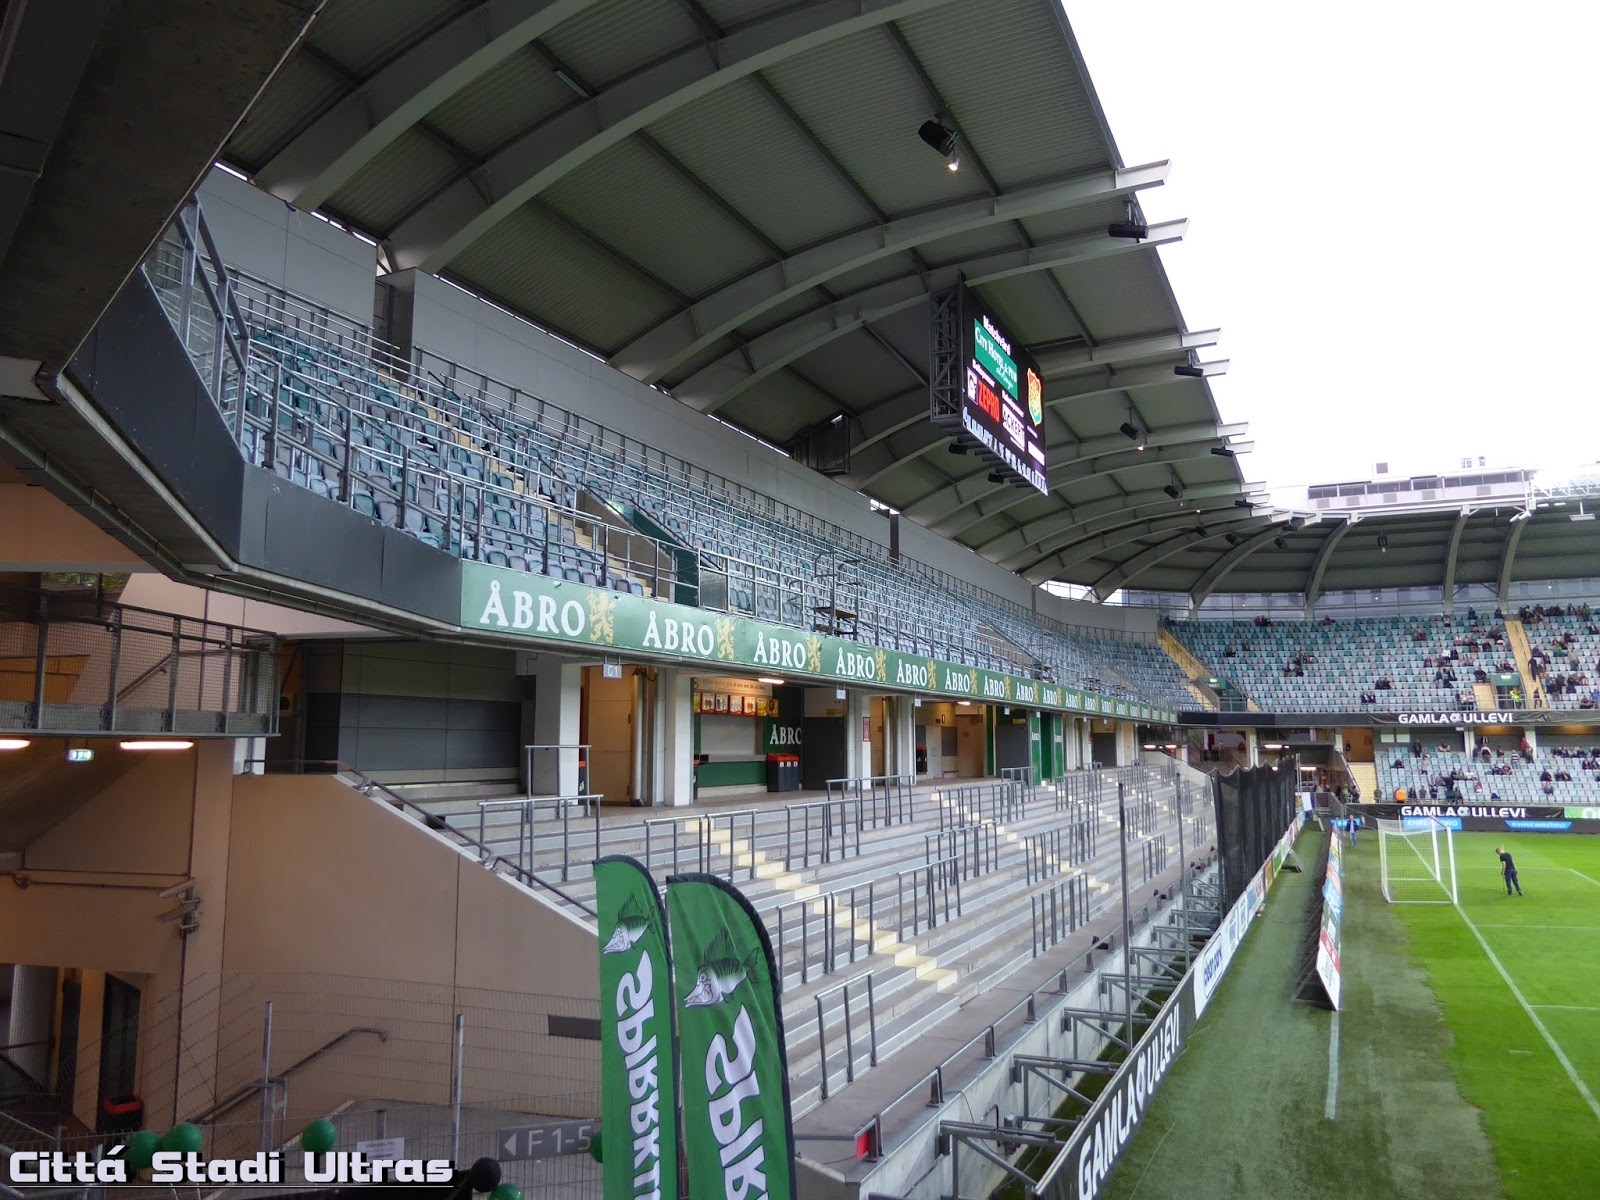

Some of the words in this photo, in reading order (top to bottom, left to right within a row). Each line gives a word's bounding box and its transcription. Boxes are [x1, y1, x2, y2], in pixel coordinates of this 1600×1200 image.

[978, 380, 1000, 423] ZEPRO
[480, 580, 586, 637] ÅBRO
[642, 610, 714, 655] ÅBRO
[753, 632, 807, 669] ÅBRO
[835, 647, 875, 679] ÅBRO
[896, 659, 927, 687] ÅBRO
[945, 668, 970, 692] ÅBRO
[1398, 713, 1450, 724] GAMLA
[1463, 712, 1513, 723] ULLEVI
[769, 723, 802, 745] ÅBRO
[1401, 806, 1457, 817] GAMLA
[1471, 806, 1526, 818] ULLEVI
[1078, 1073, 1138, 1200] GAMLA
[1147, 1002, 1180, 1094] ULLEVI
[528, 1129, 543, 1156] F
[552, 1125, 592, 1152] 1-5
